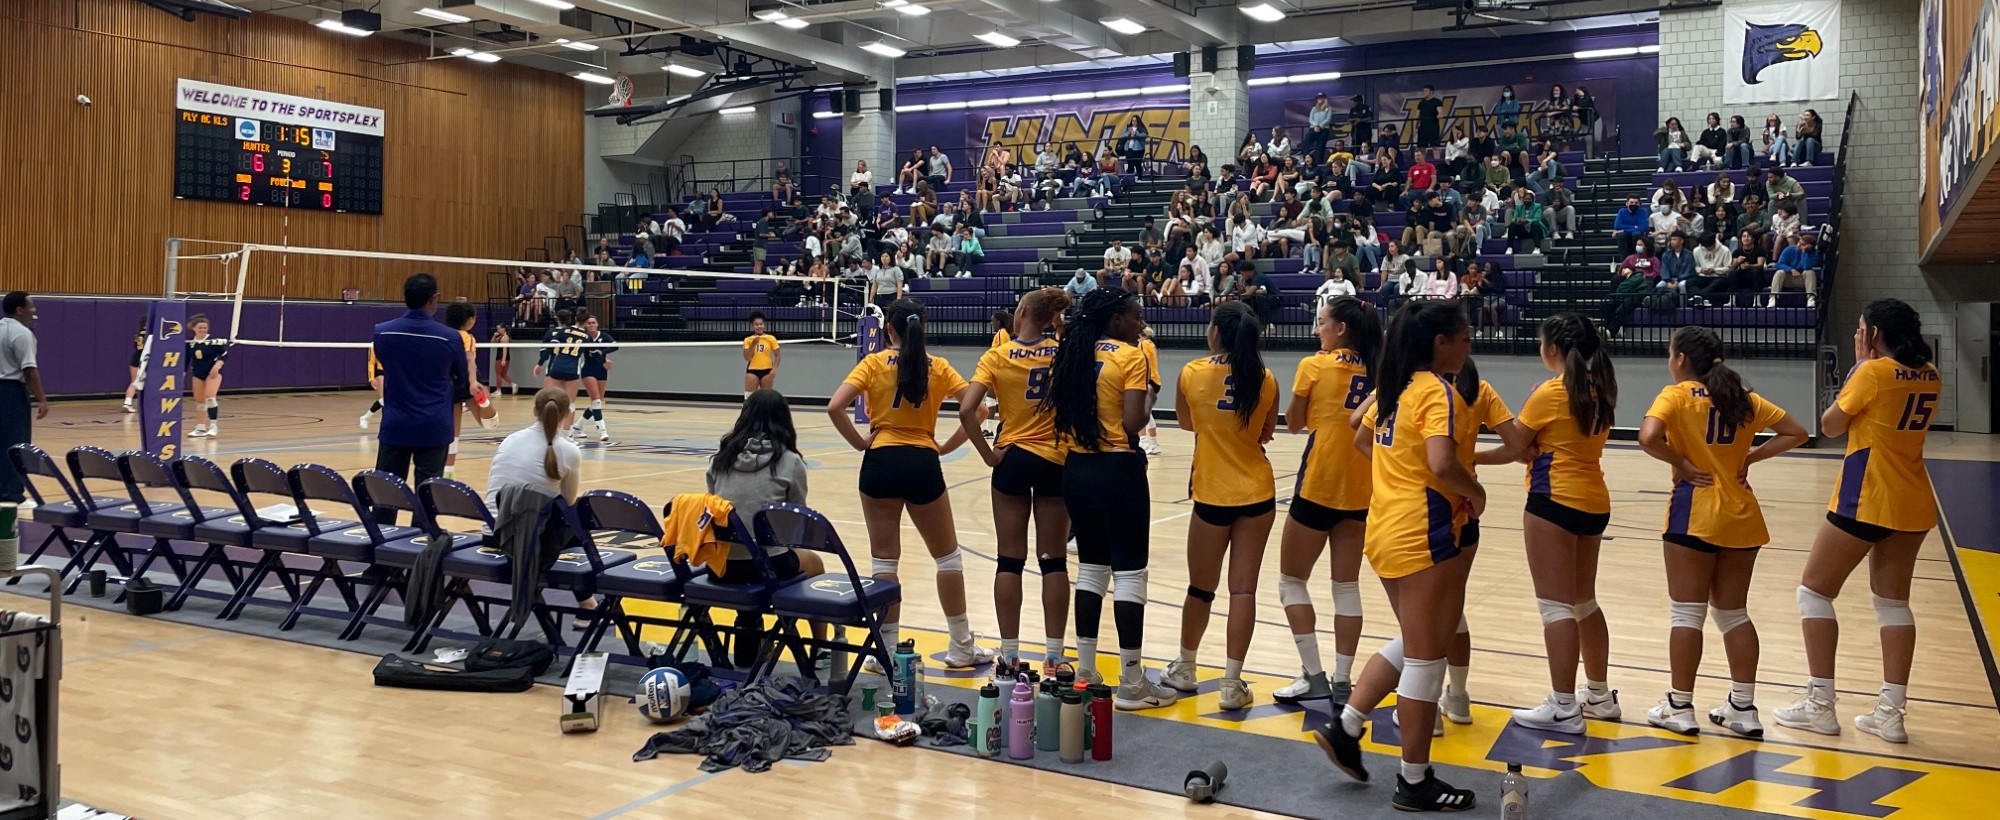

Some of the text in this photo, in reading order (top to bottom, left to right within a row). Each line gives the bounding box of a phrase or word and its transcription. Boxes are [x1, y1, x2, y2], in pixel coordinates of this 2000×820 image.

[182, 88, 380, 127] WELCOME TO THE SPORTSPLEX
[1398, 96, 1583, 147] HAWK
[243, 141, 270, 152] HUNTER
[253, 153, 264, 172] 6
[282, 158, 291, 173] 3
[323, 161, 332, 178] 7
[241, 185, 250, 200] 2
[323, 194, 331, 208] 0
[756, 344, 765, 353] 13
[1026, 366, 1051, 400] 9
[1344, 375, 1375, 410] 8
[1896, 393, 1938, 431] 15
[648, 681, 659, 713] molten
